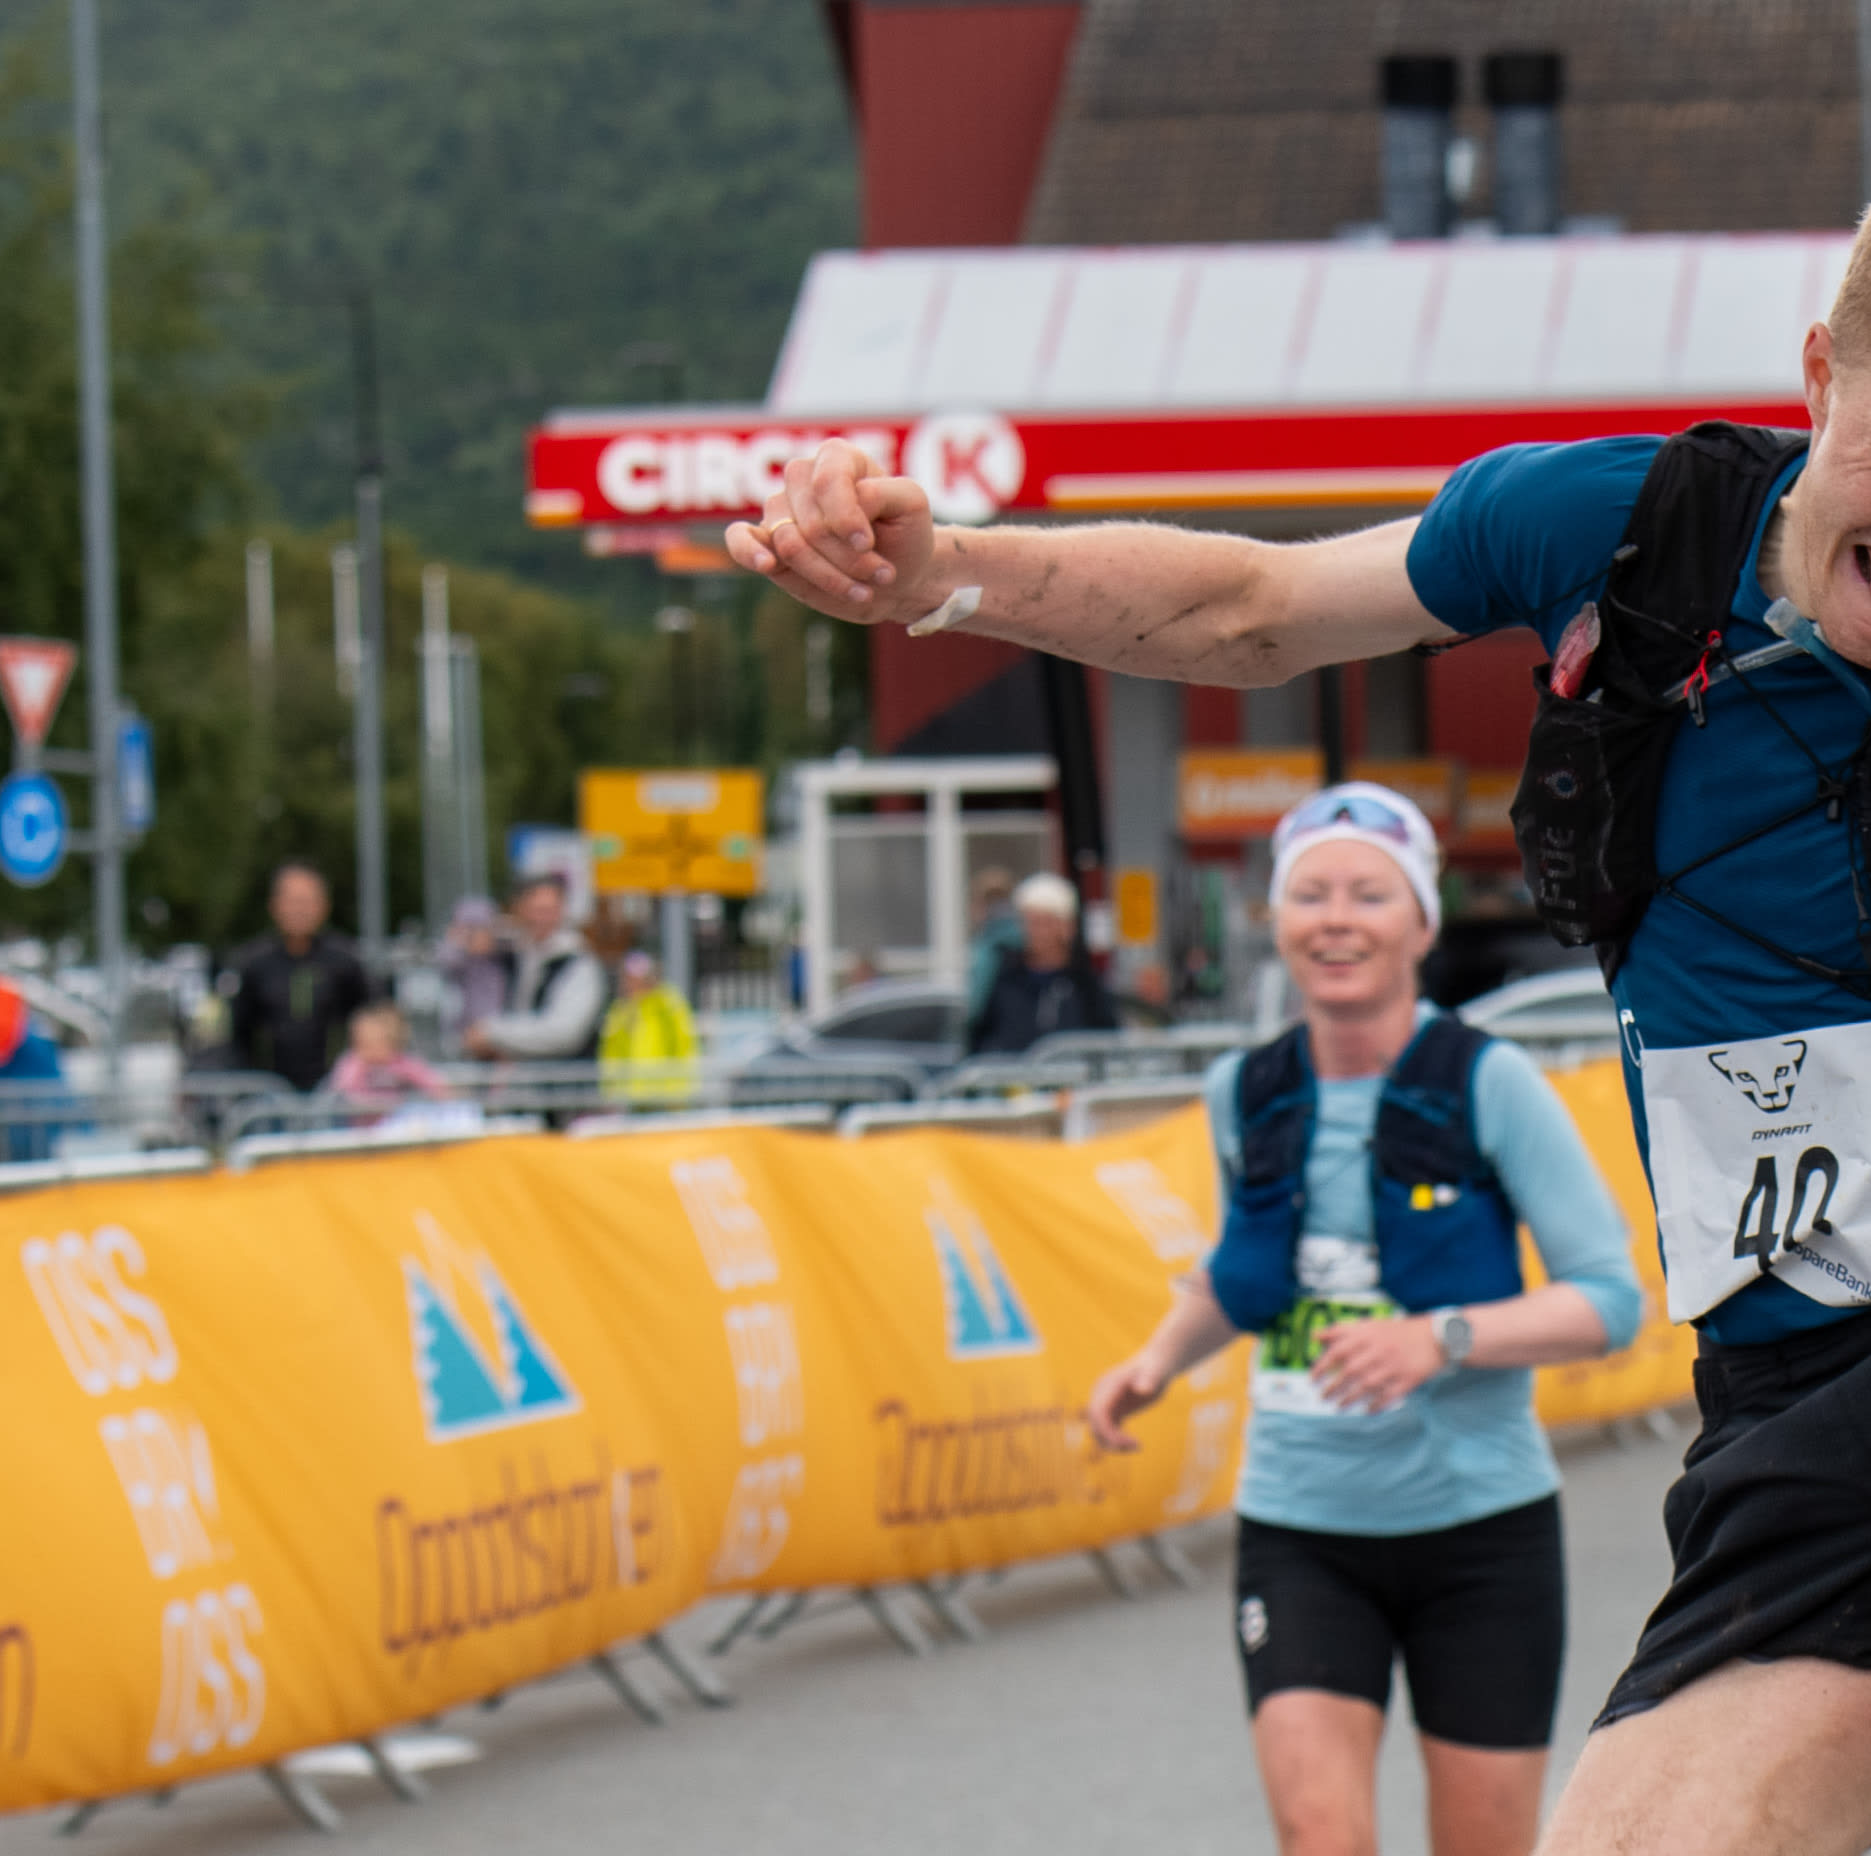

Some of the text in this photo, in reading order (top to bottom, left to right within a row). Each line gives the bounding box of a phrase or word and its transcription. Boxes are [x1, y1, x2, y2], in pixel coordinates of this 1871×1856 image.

[597, 432, 892, 513] CIRC
[1752, 1123, 1813, 1140] DYNAFIT
[1734, 1146, 1839, 1273] 40
